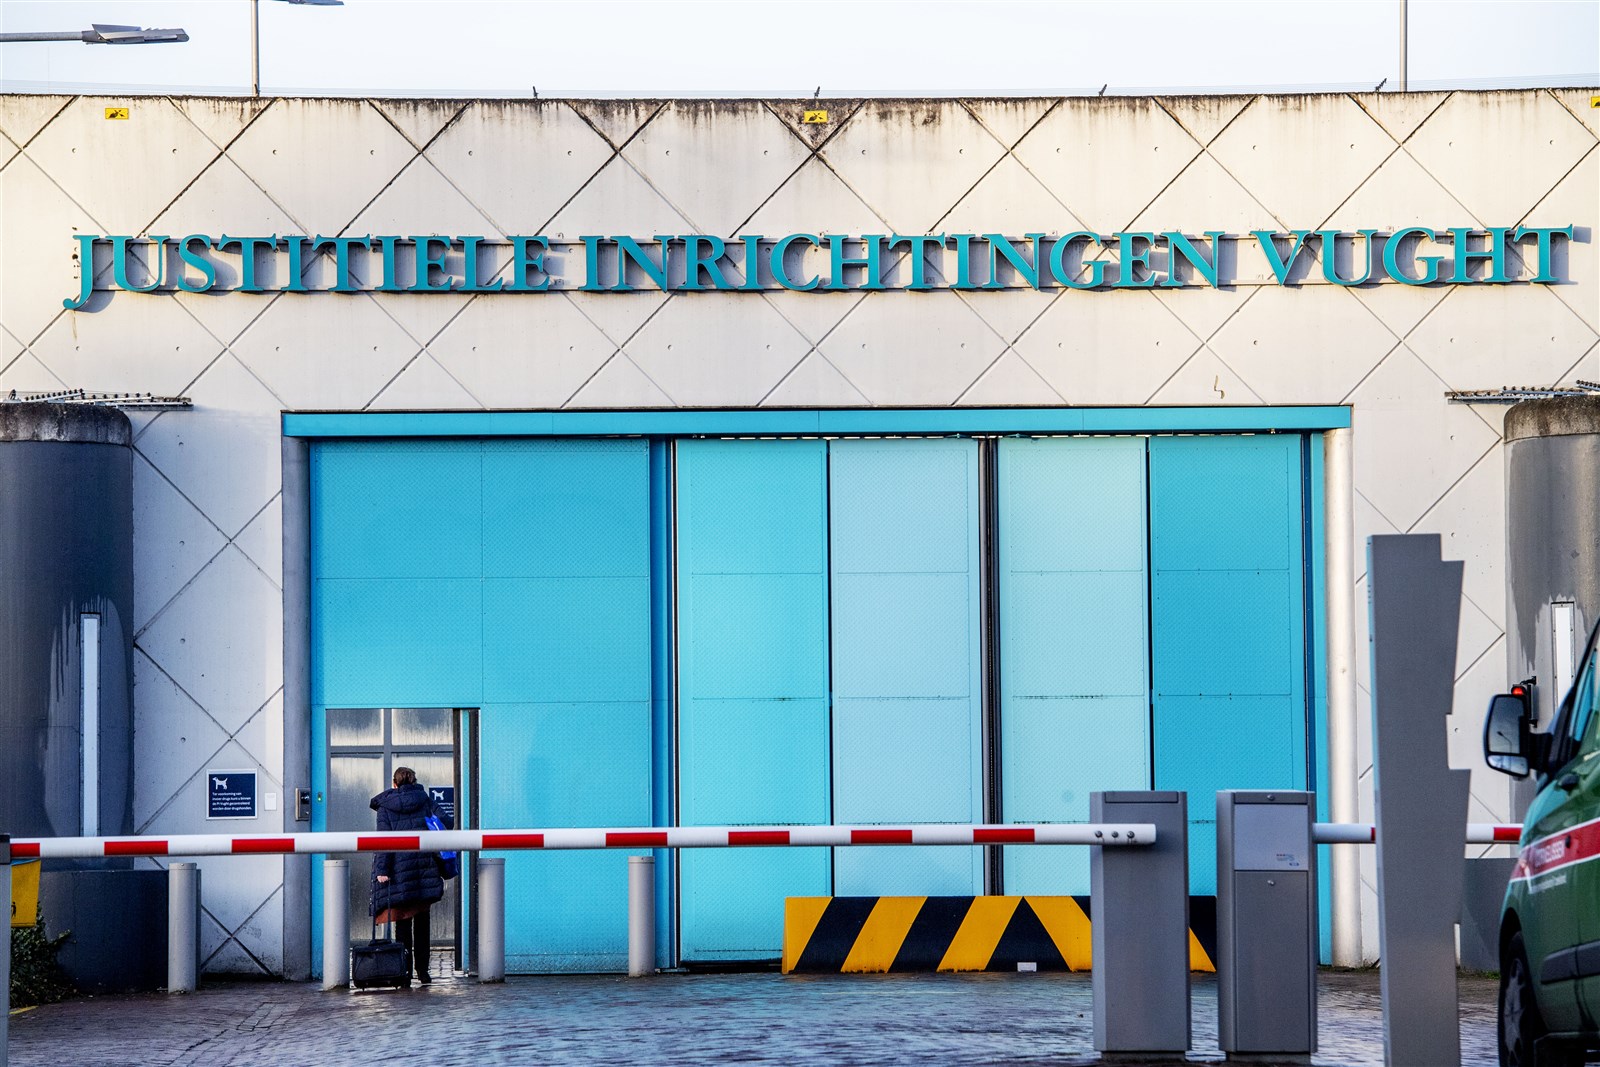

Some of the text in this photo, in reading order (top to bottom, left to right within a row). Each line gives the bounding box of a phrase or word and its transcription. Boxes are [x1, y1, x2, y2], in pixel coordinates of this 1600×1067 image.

[63, 224, 1573, 309] JUSTITIELE INRICHTINGEN VUGHT
